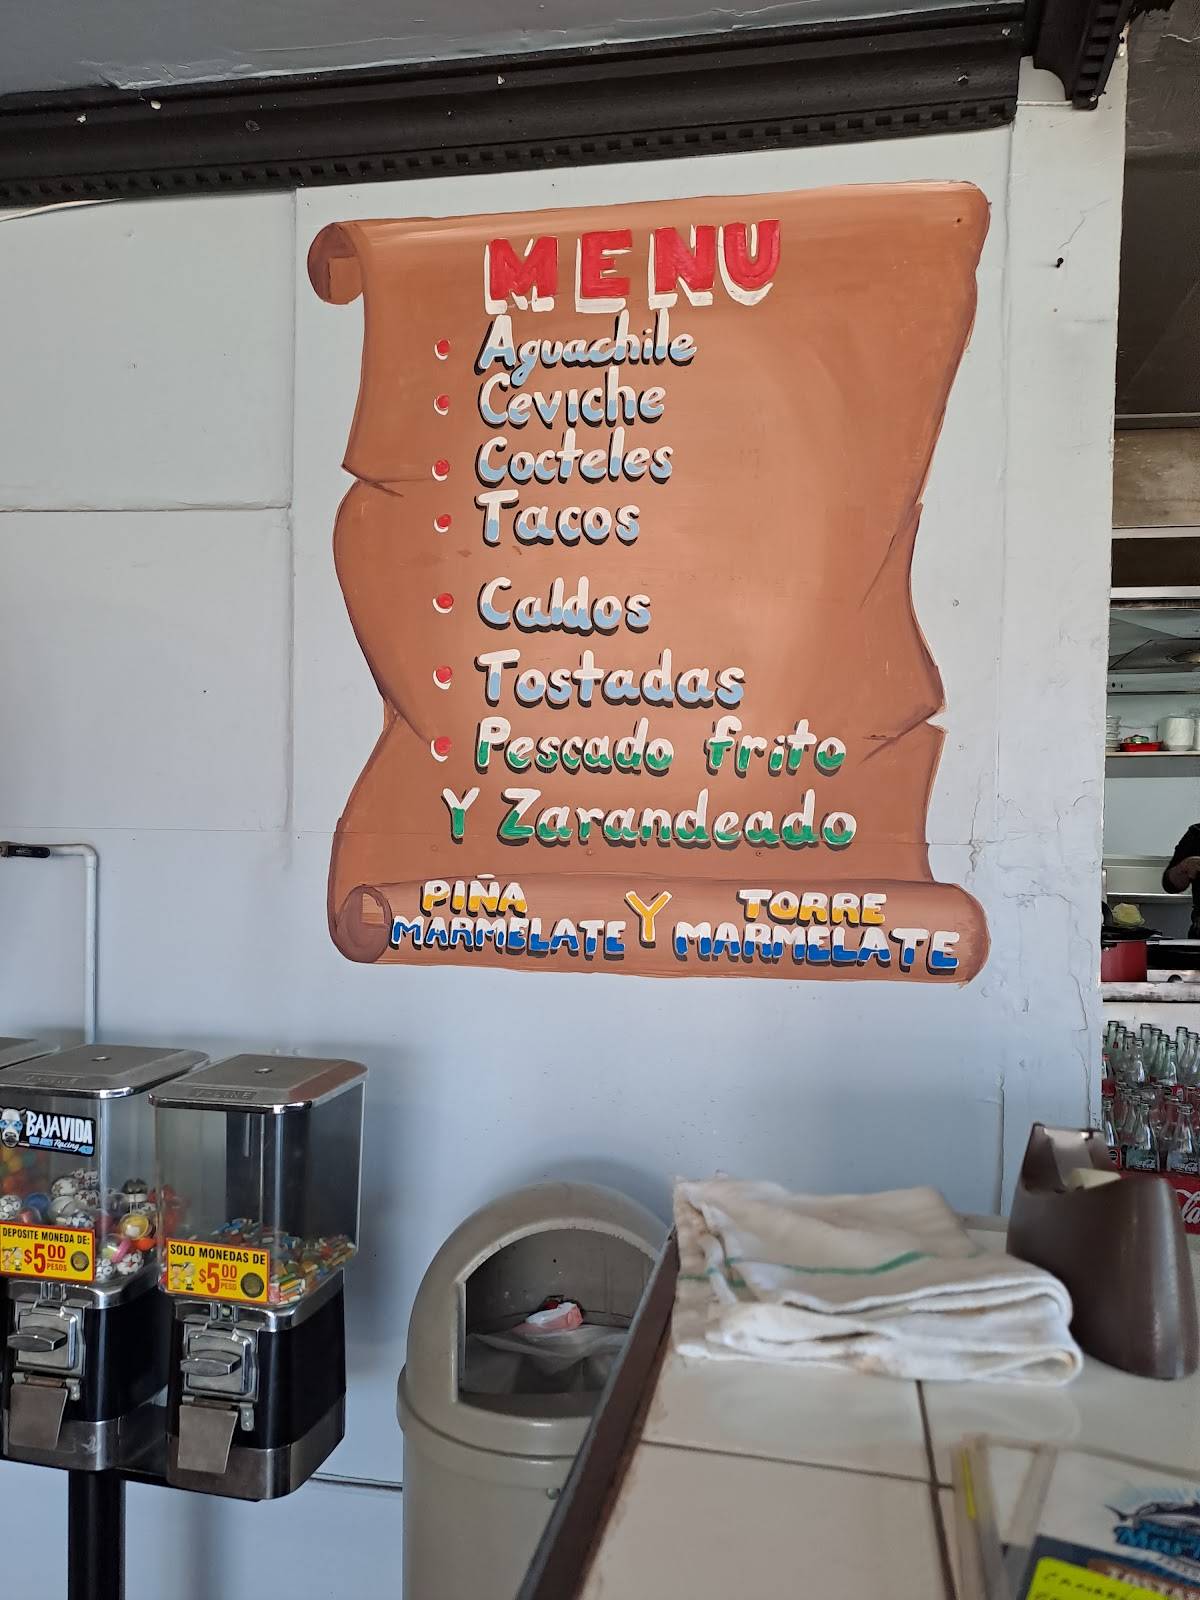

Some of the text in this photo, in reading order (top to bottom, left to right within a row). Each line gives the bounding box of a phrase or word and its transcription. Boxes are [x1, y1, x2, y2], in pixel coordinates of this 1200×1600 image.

[484, 219, 781, 314] MENU
[474, 307, 698, 388] Aguachile
[477, 366, 667, 427] Ceviche
[474, 426, 674, 486] Cocteles
[475, 490, 641, 546] Tacos
[478, 577, 652, 636] Caldos
[475, 648, 746, 710] Tostadas
[474, 715, 847, 777] Pescado frito
[441, 787, 858, 854] Y Zarandeado
[420, 873, 529, 917] PIÑA
[624, 889, 673, 947] Y
[737, 888, 887, 927] TORRE
[389, 915, 628, 960] MARMELATE
[672, 920, 961, 974] MARMELATE
[53, 1140, 80, 1153] Racing
[2, 1227, 39, 1240] DEPOSITE
[41, 1231, 75, 1244] MONEDA
[170, 1244, 266, 1265] SOLO MONEDAS DE
